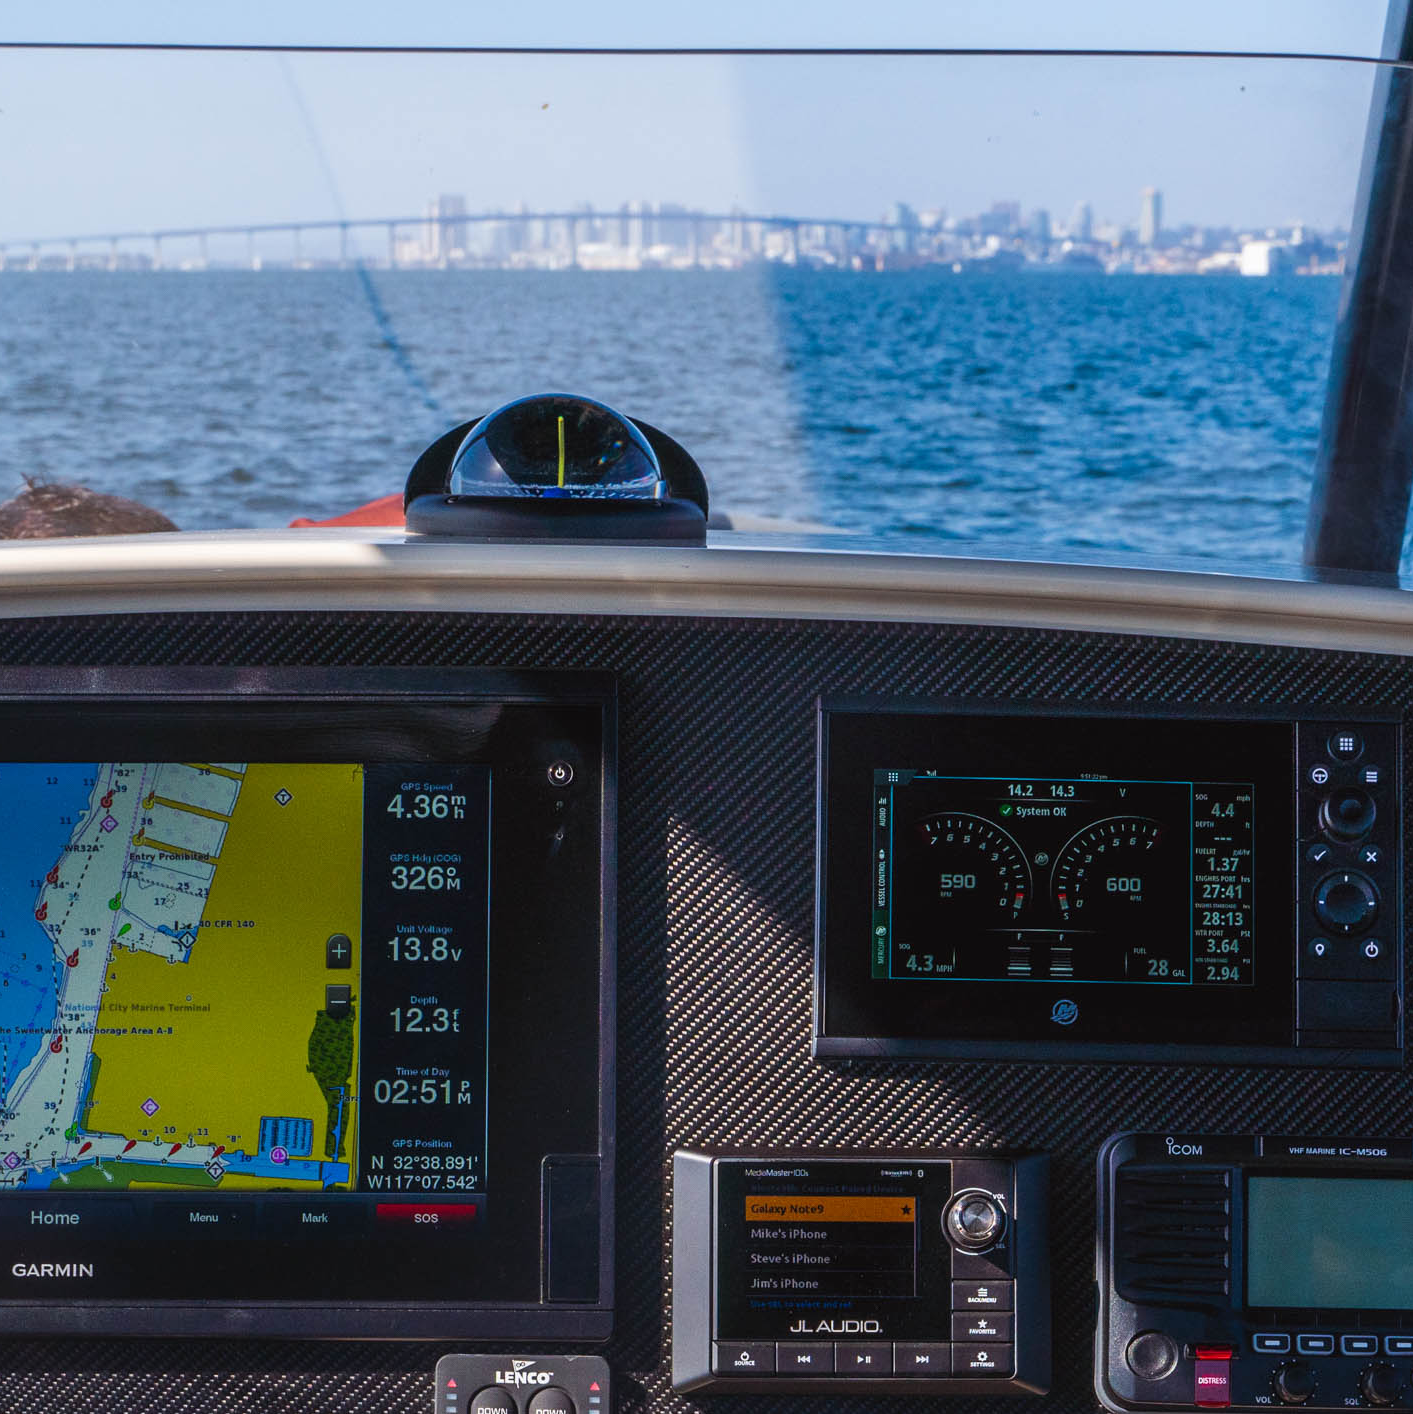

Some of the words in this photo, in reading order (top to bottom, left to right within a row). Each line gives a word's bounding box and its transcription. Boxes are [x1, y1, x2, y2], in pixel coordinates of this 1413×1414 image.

[401, 782, 420, 792] GPS
[424, 782, 453, 794] Speed
[1008, 785, 1034, 798] 14.2
[1050, 785, 1075, 798] 14.3
[386, 794, 448, 819] 4.36
[1016, 806, 1050, 820] System
[1053, 806, 1067, 818] OK
[1211, 802, 1235, 817] 4.4
[130, 853, 156, 864] Entry
[159, 852, 210, 862] Prohibited
[390, 854, 409, 863] GPS
[412, 854, 431, 865] Hdg
[433, 854, 462, 865] (COG)
[1207, 857, 1239, 872] 1.37
[940, 874, 975, 889] 590
[1106, 877, 1141, 893] 600
[1202, 884, 1243, 899] 27:41
[1202, 911, 1243, 926] 28:13
[396, 924, 415, 934] Unit
[418, 924, 453, 936] Voltage
[388, 937, 448, 961] 13.8
[1133, 946, 1147, 955] FUEL
[1206, 938, 1240, 953] 3.64
[906, 954, 935, 972] 4.3
[936, 963, 954, 973] MPH
[1147, 959, 1169, 977] 28
[1172, 968, 1186, 978] GAL
[1206, 965, 1241, 981] 2.94
[410, 995, 439, 1006] Depth
[109, 1002, 128, 1014] City
[390, 1007, 450, 1032] 12.3
[75, 1026, 127, 1037] Anchorage
[131, 1026, 153, 1035] Area
[395, 1066, 418, 1076] Time
[420, 1066, 430, 1076] of
[432, 1066, 451, 1078] Day
[374, 1080, 451, 1104] 02:51
[392, 1139, 412, 1149] GPS
[415, 1139, 453, 1149] Position
[1289, 1146, 1305, 1155] VHF
[1306, 1146, 1336, 1156] MARINE
[1339, 1146, 1388, 1158] IC-M506
[371, 1155, 384, 1170] N
[750, 1203, 787, 1215] Galaxy
[790, 1203, 825, 1214] Note9
[30, 1210, 80, 1224] Home
[189, 1212, 219, 1222] Menu
[302, 1212, 329, 1222] Mark
[414, 1213, 439, 1223] SOS
[750, 1228, 787, 1239] Mike's
[789, 1228, 827, 1239] iPhone
[750, 1252, 790, 1264] Steve's
[792, 1252, 831, 1264] iPhone
[12, 1263, 94, 1278] GARMIN
[750, 1277, 779, 1289] Jim's
[780, 1277, 819, 1289] iPhone
[790, 1319, 814, 1333] JL
[496, 1371, 551, 1386] LENCO
[1198, 1377, 1227, 1385] DISTRESS
[1255, 1396, 1273, 1405] VOL
[1344, 1396, 1360, 1406] SQL
